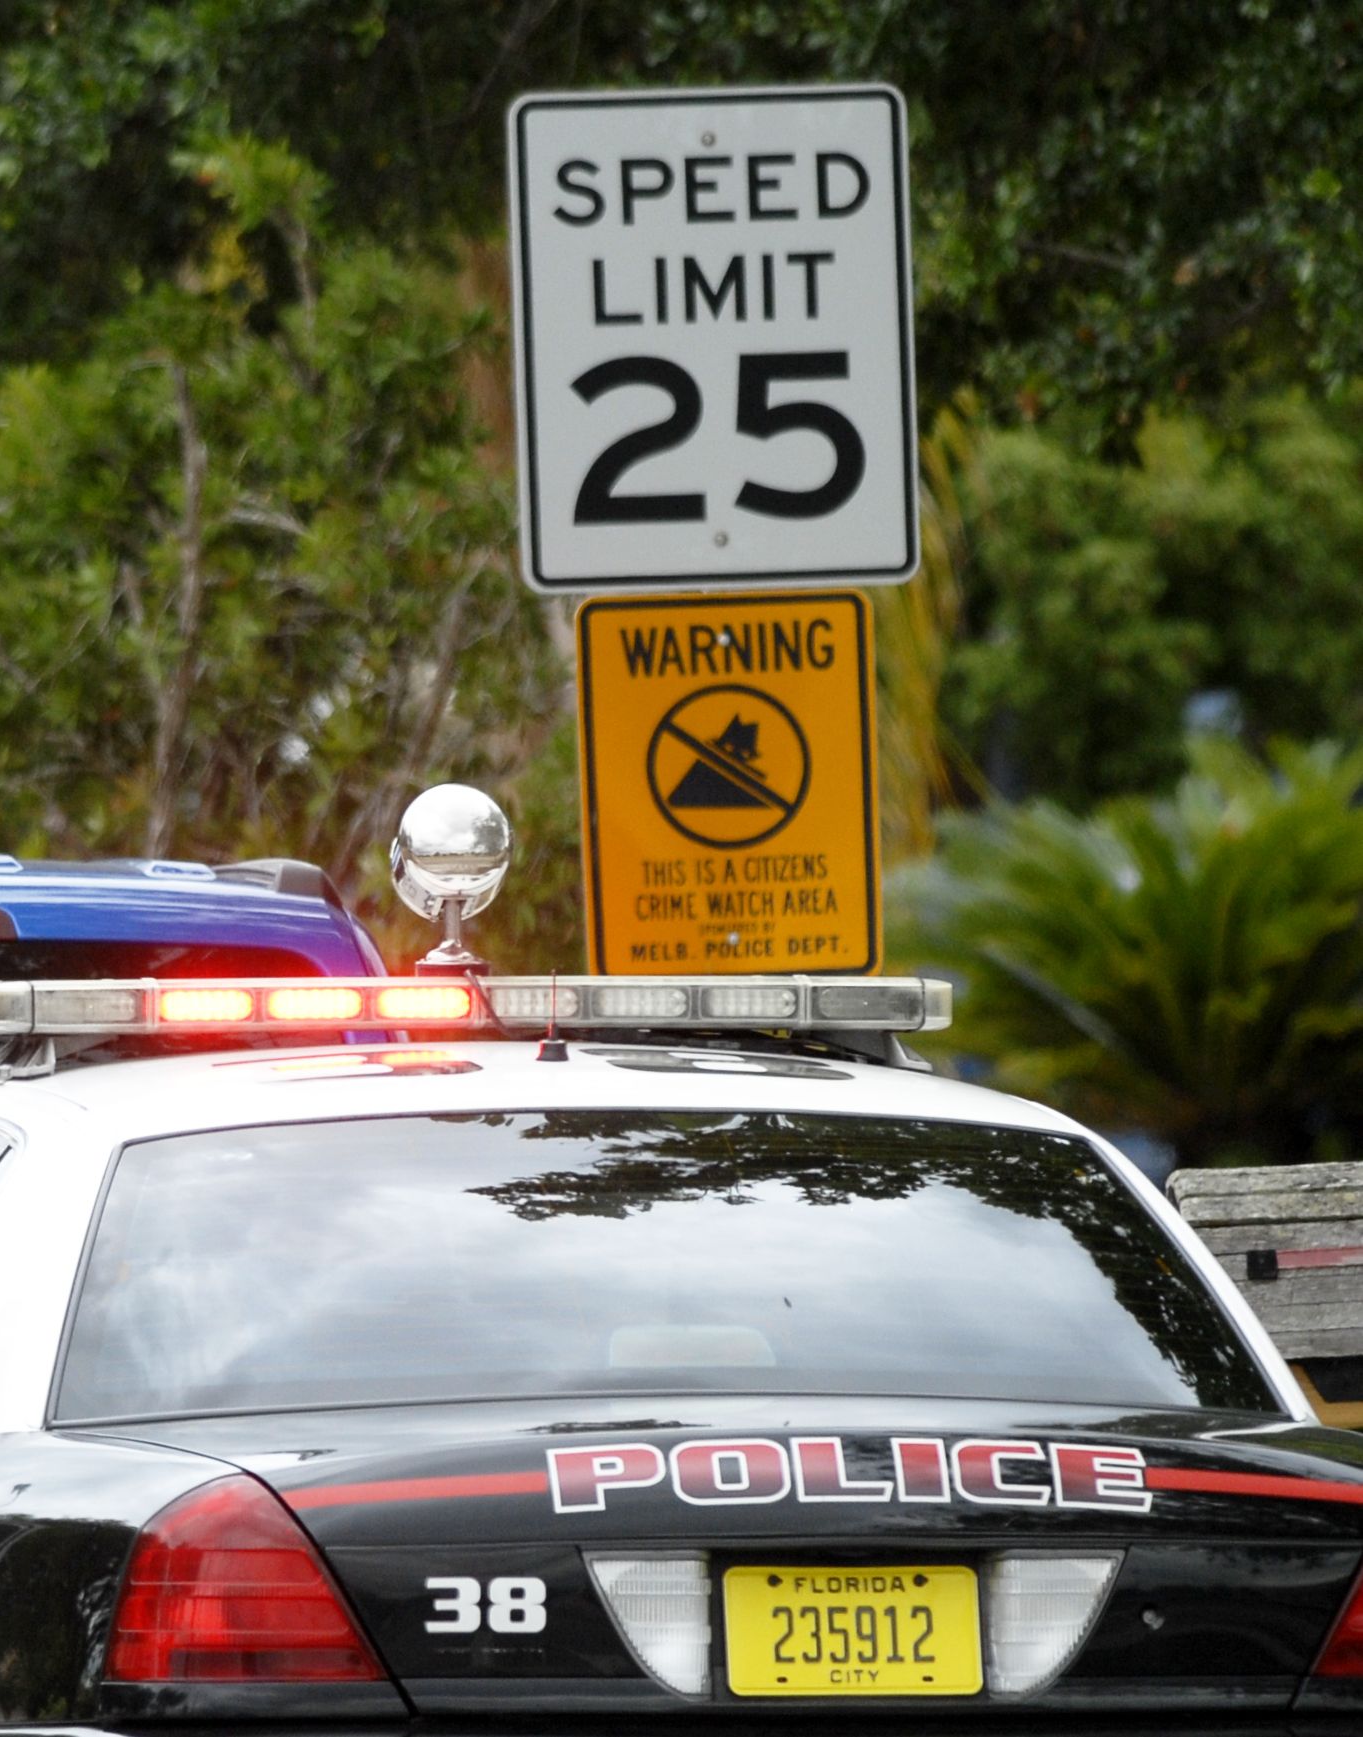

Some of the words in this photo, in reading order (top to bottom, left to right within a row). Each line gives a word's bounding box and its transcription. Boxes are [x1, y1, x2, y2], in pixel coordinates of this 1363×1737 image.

[552, 151, 871, 227] SPEED
[592, 251, 836, 327] LIMIT
[569, 350, 867, 526] 25
[619, 618, 836, 677] WARNING
[642, 860, 687, 887] THIS
[696, 858, 716, 885] IS
[723, 858, 737, 884] A
[744, 854, 829, 883] CITIZENS
[635, 893, 697, 921] CRIME
[707, 890, 775, 918] WATCH
[782, 888, 839, 915] AREA
[705, 939, 775, 959] POLICE
[788, 936, 850, 956] DEPT.
[547, 1437, 1153, 1514] POLICE
[424, 1576, 547, 1633] 38
[793, 1576, 906, 1594] FLORIDA
[772, 1605, 936, 1664] 235912
[830, 1669, 879, 1684] CITY
